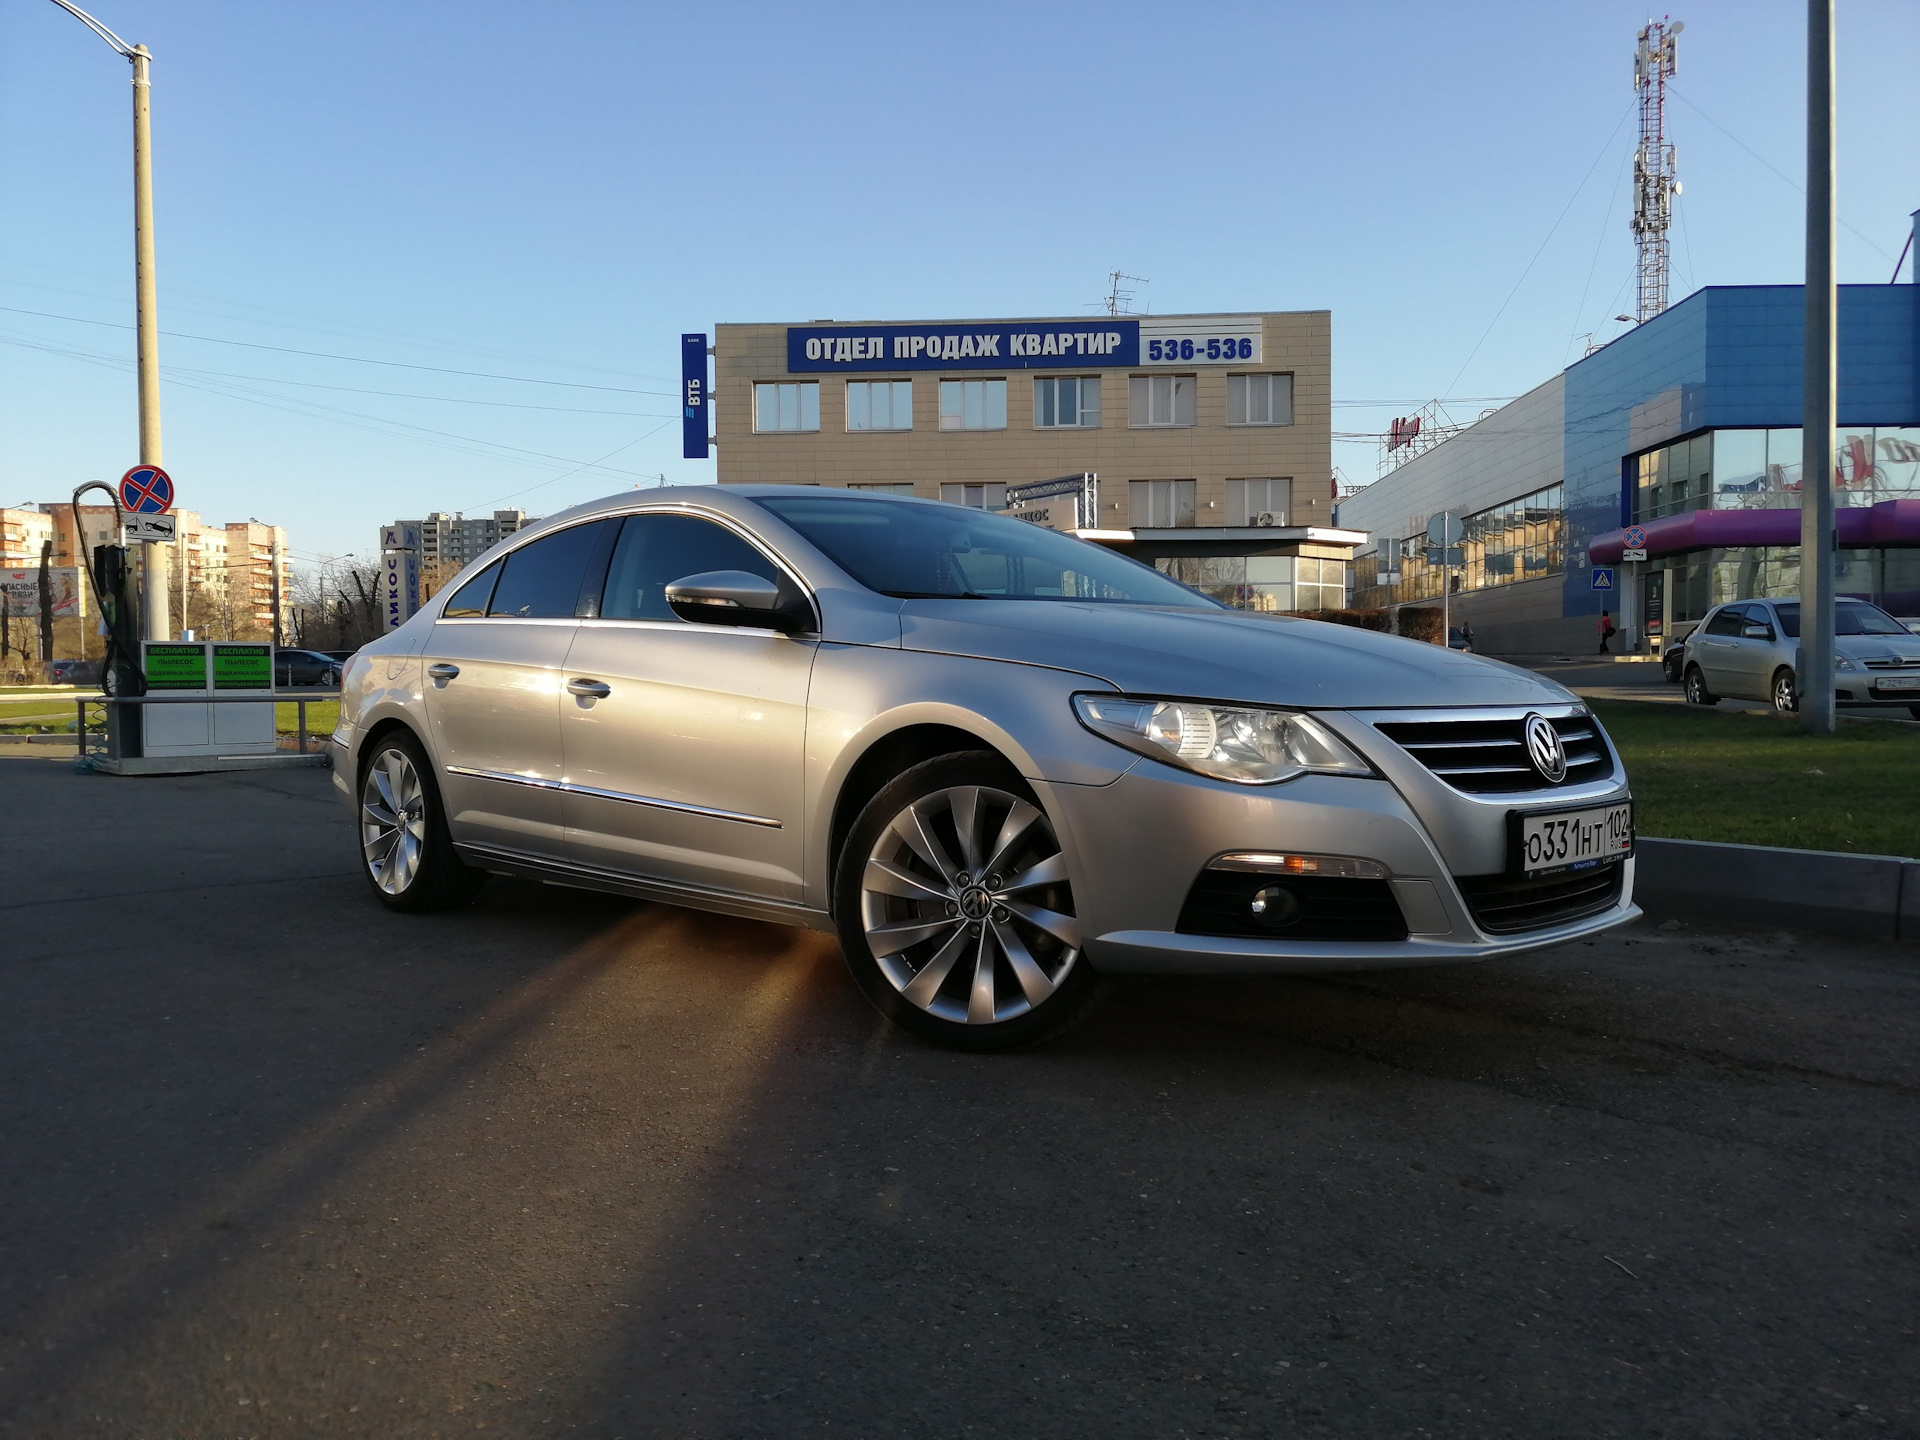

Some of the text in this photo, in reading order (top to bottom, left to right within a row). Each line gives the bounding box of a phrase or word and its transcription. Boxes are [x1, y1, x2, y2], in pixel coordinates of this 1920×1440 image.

[805, 332, 1121, 361] ОТДЕЛ ПРОДАЖ КВАРТИР
[1149, 337, 1252, 361] 536-536
[687, 379, 700, 405] ВТБ
[388, 559, 399, 627] ЛИКОС
[1528, 808, 1628, 864] О331НТ 102
[1610, 838, 1622, 851] RUS
